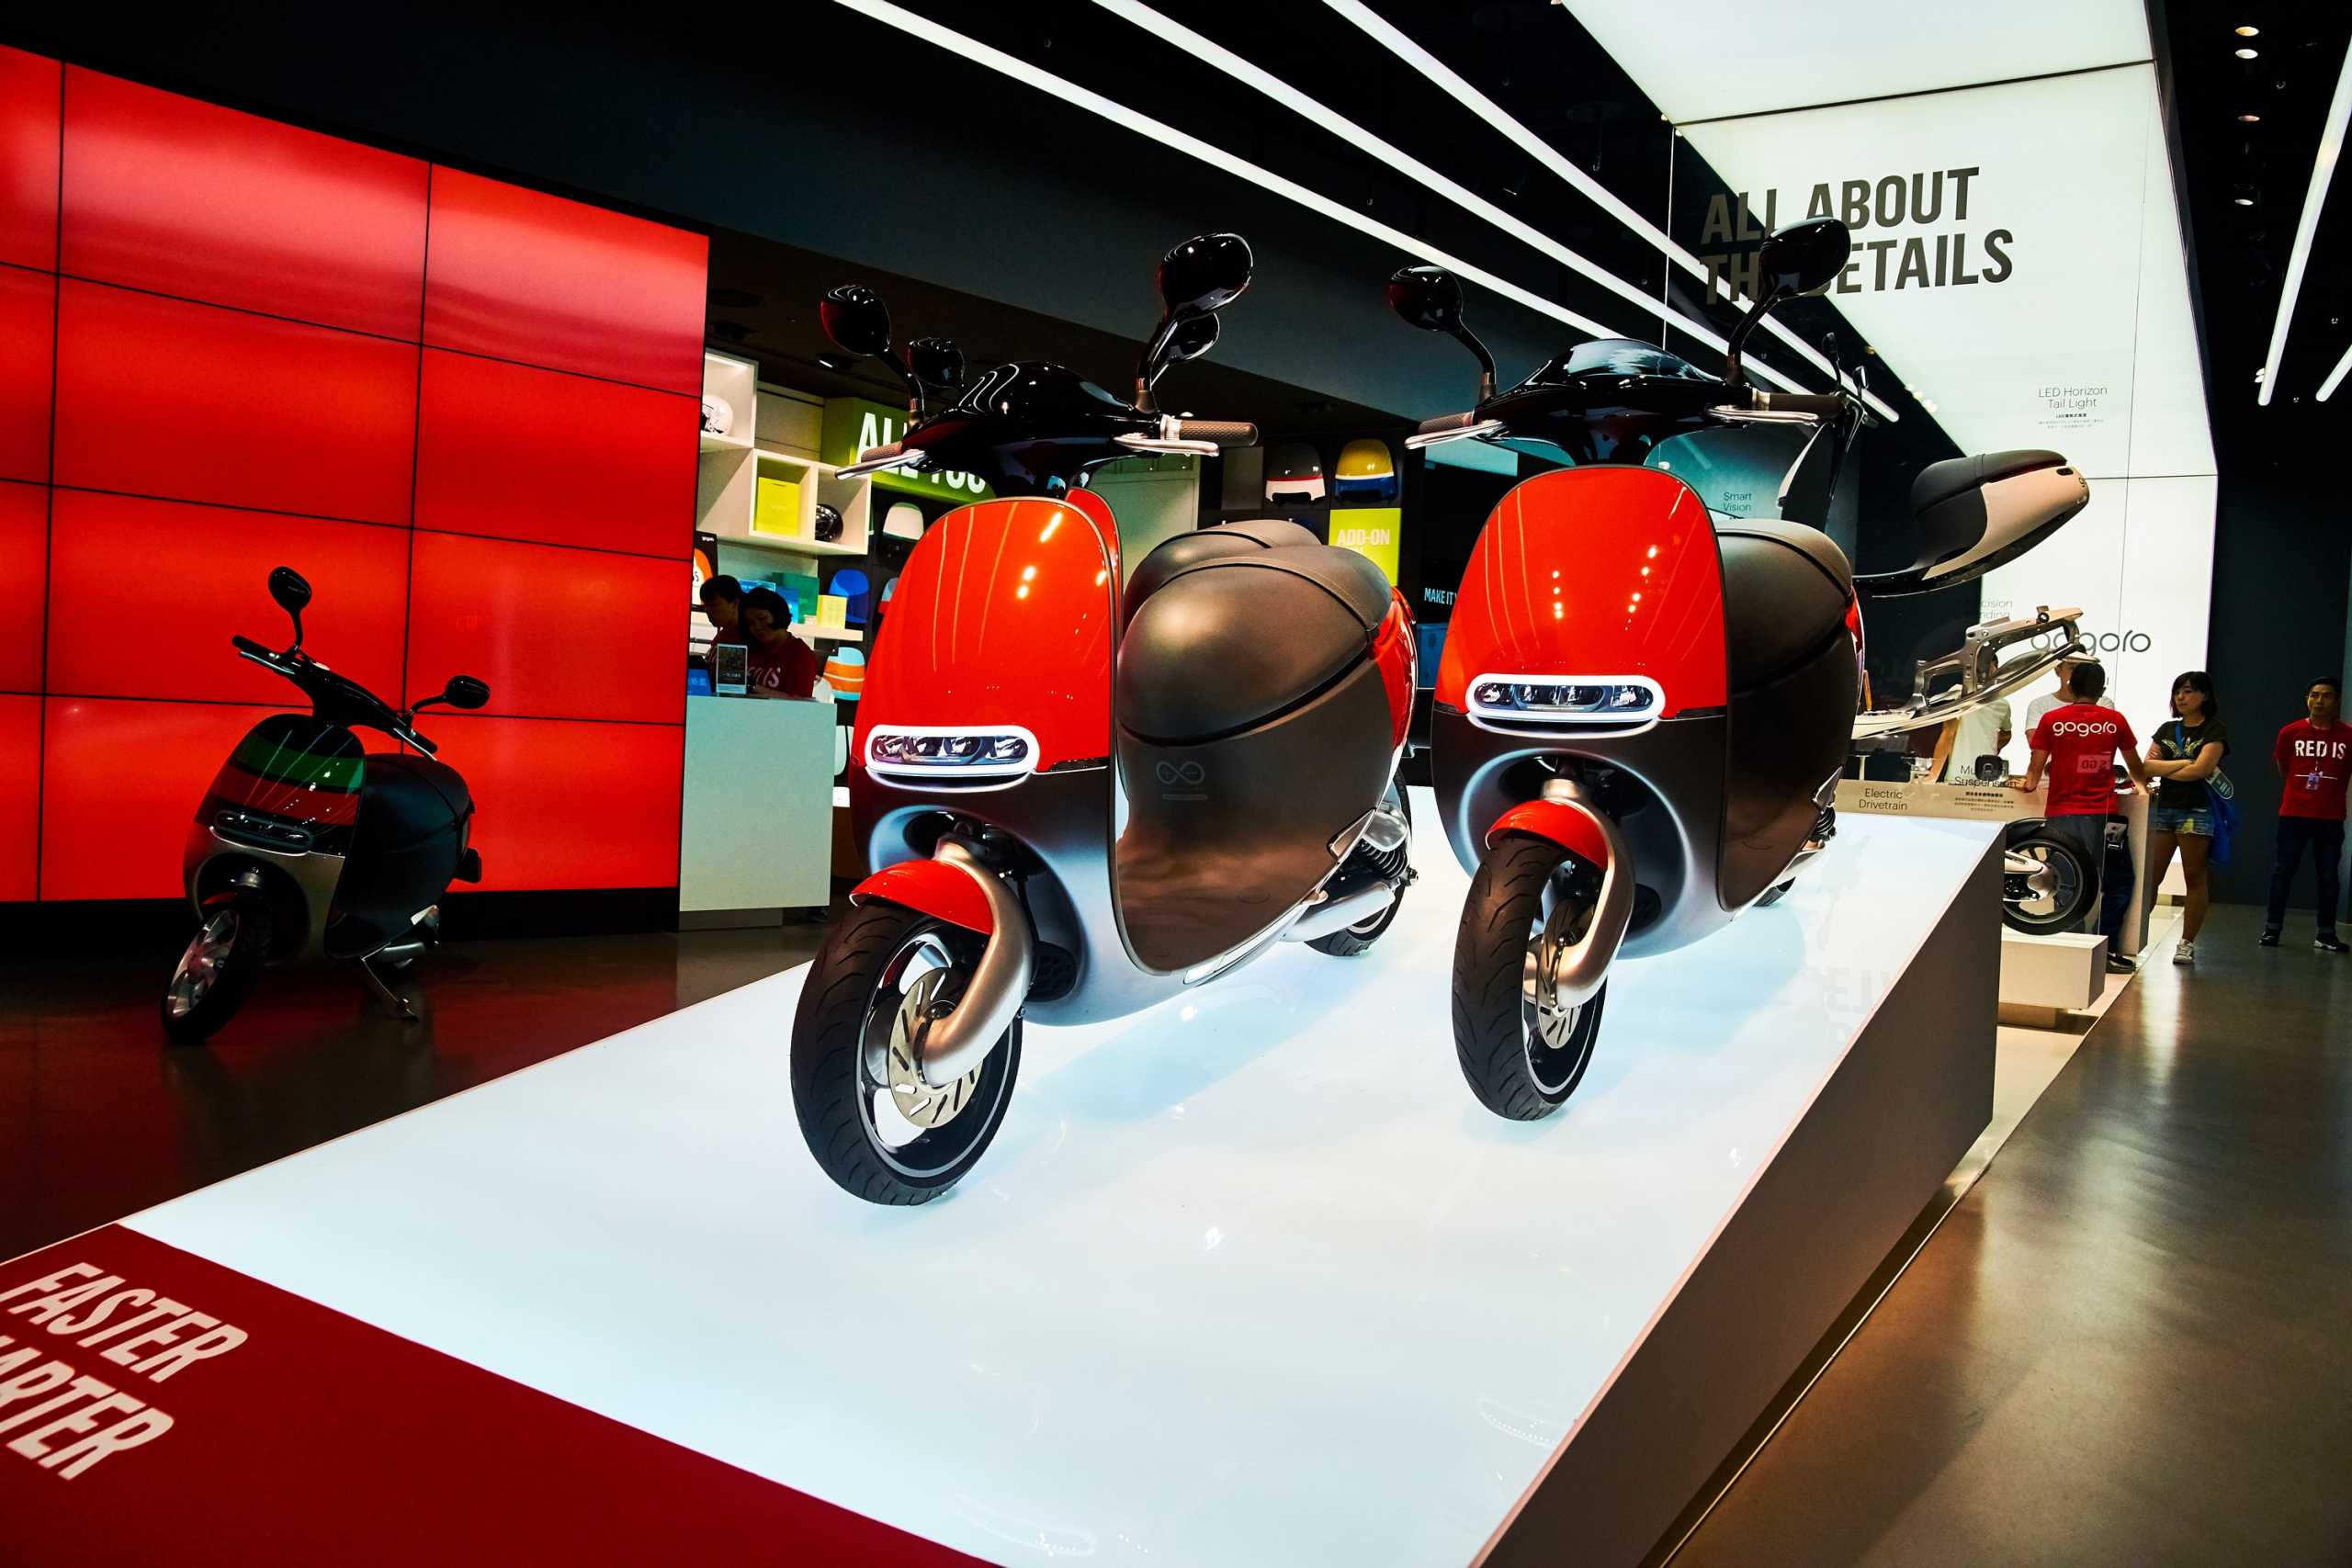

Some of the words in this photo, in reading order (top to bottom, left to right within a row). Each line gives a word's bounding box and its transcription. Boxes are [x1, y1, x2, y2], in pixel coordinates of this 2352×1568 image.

[1701, 188, 1778, 245] ALL
[1805, 166, 1980, 231] ABOUT
[1804, 229, 2014, 298] ETAILS
[2039, 387, 2061, 398] LED
[2064, 386, 2108, 396] Horizon
[2049, 398, 2065, 409] Tail
[2068, 397, 2098, 410] Light
[1723, 491, 1753, 502] Smart
[1723, 502, 1752, 512] Vision
[1338, 529, 1390, 546] ADD-ON
[1424, 587, 1445, 604] MAKE
[1446, 589, 1453, 606] IT
[2052, 721, 2117, 737] gogoro
[2294, 739, 2327, 758] RED
[2332, 741, 2346, 760] IS
[1864, 788, 1904, 799] Electric
[1859, 798, 1908, 811] Drivetrain
[0, 1261, 249, 1383] FASTER
